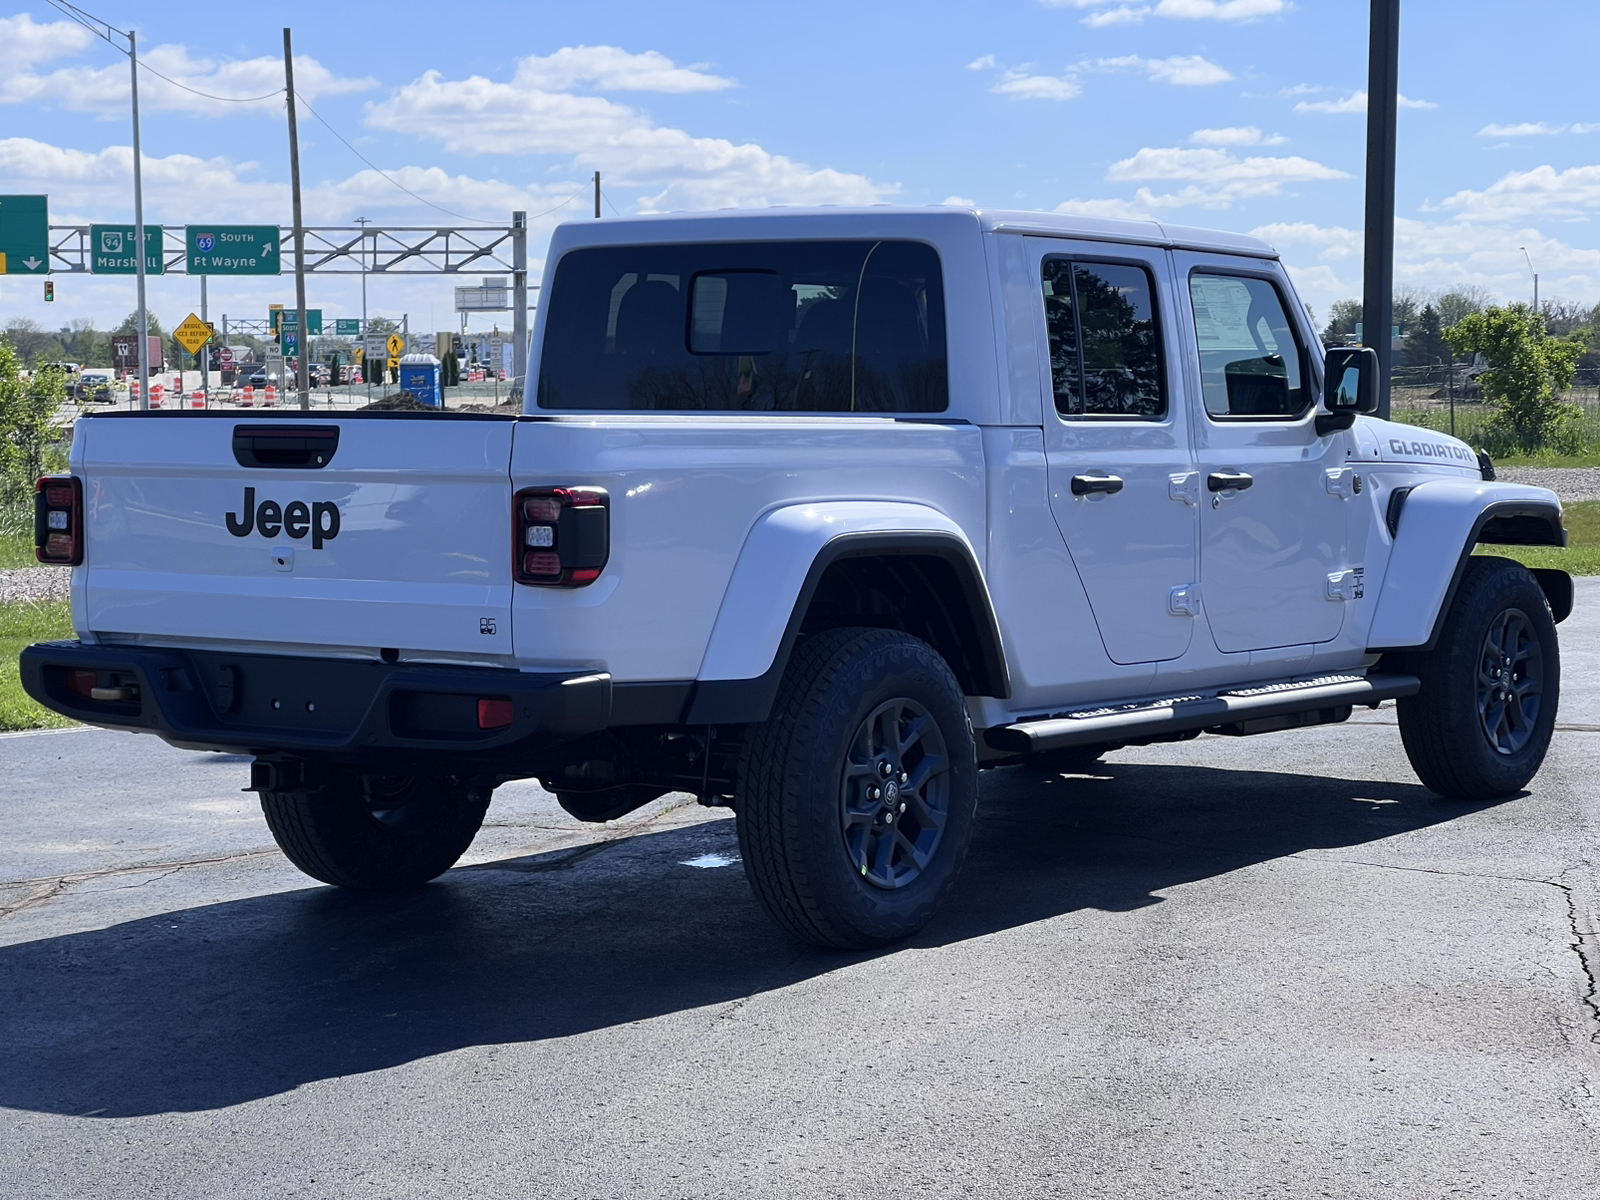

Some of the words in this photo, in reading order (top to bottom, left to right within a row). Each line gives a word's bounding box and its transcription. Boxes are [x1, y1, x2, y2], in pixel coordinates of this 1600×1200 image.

[198, 237, 212, 248] 69
[220, 232, 254, 242] SOUTH
[105, 239, 119, 248] 94
[97, 257, 157, 268] Marshll
[194, 257, 207, 267] Ft
[212, 257, 256, 269] Wayne
[286, 335, 295, 343] 69
[1389, 439, 1472, 461] GLADIATOR
[225, 486, 340, 550] Jeep
